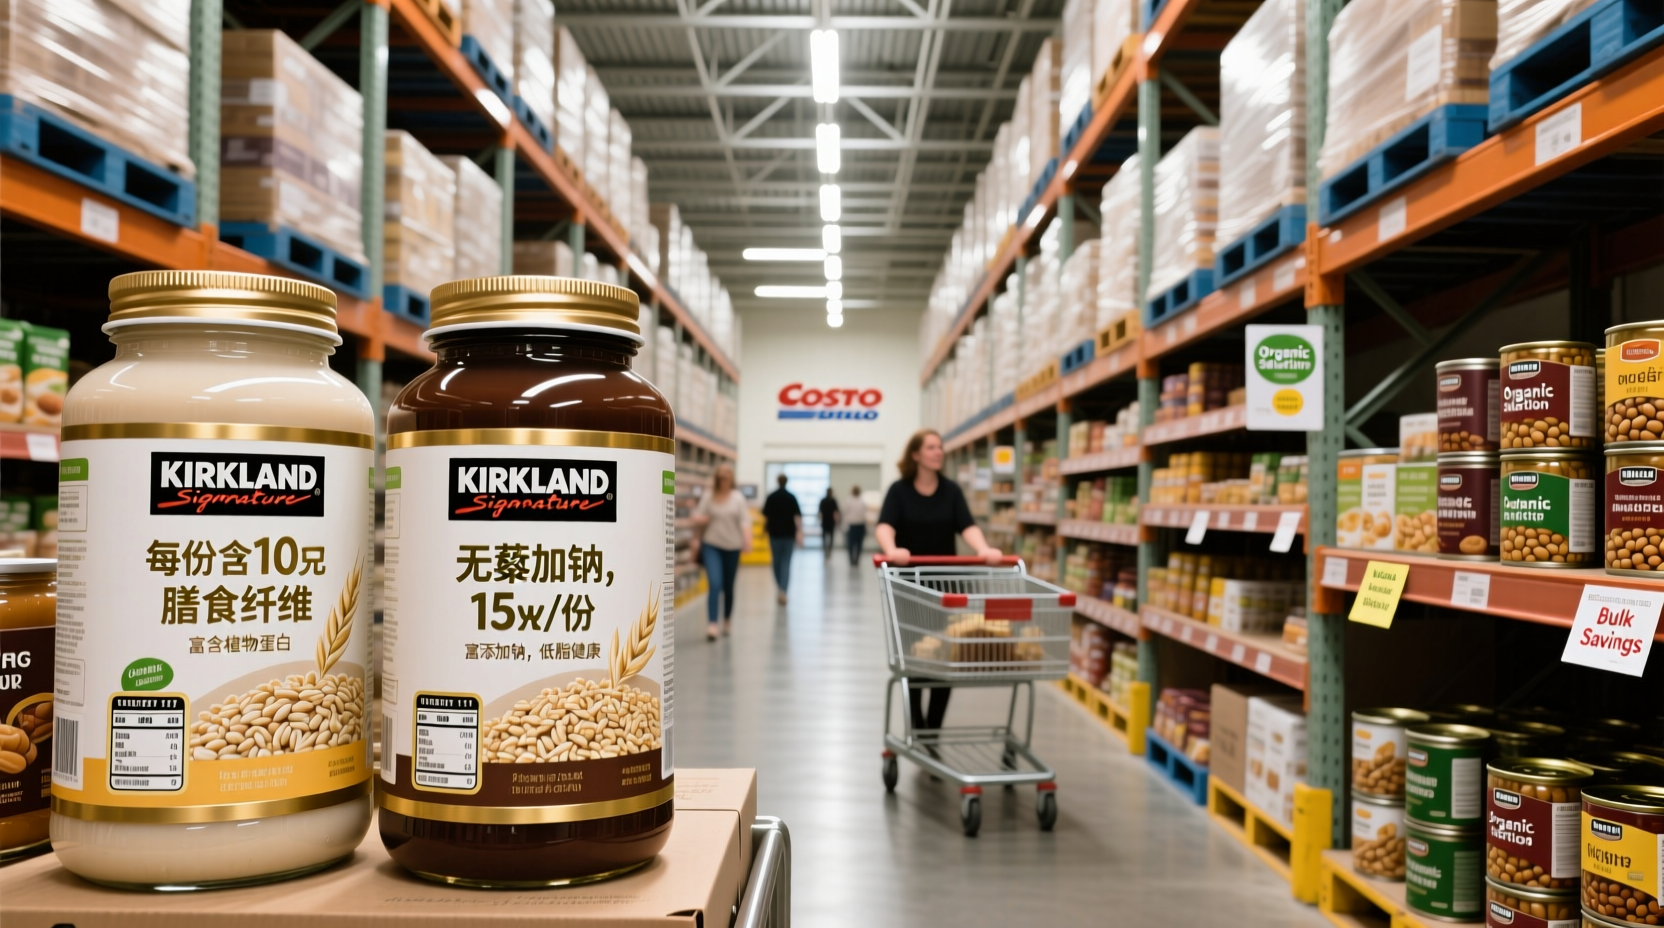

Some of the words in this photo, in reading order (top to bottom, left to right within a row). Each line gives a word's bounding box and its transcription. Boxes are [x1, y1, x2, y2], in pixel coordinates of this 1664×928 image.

[161, 461, 317, 490] KIRKLAND
[458, 467, 609, 494] KIRKLAND
[161, 584, 313, 625] 膳食纤维
[1597, 606, 1635, 628] Bulk
[189, 632, 290, 654] 富含植物蛋白
[1580, 628, 1643, 657] Savings
[0, 650, 31, 669] AG
